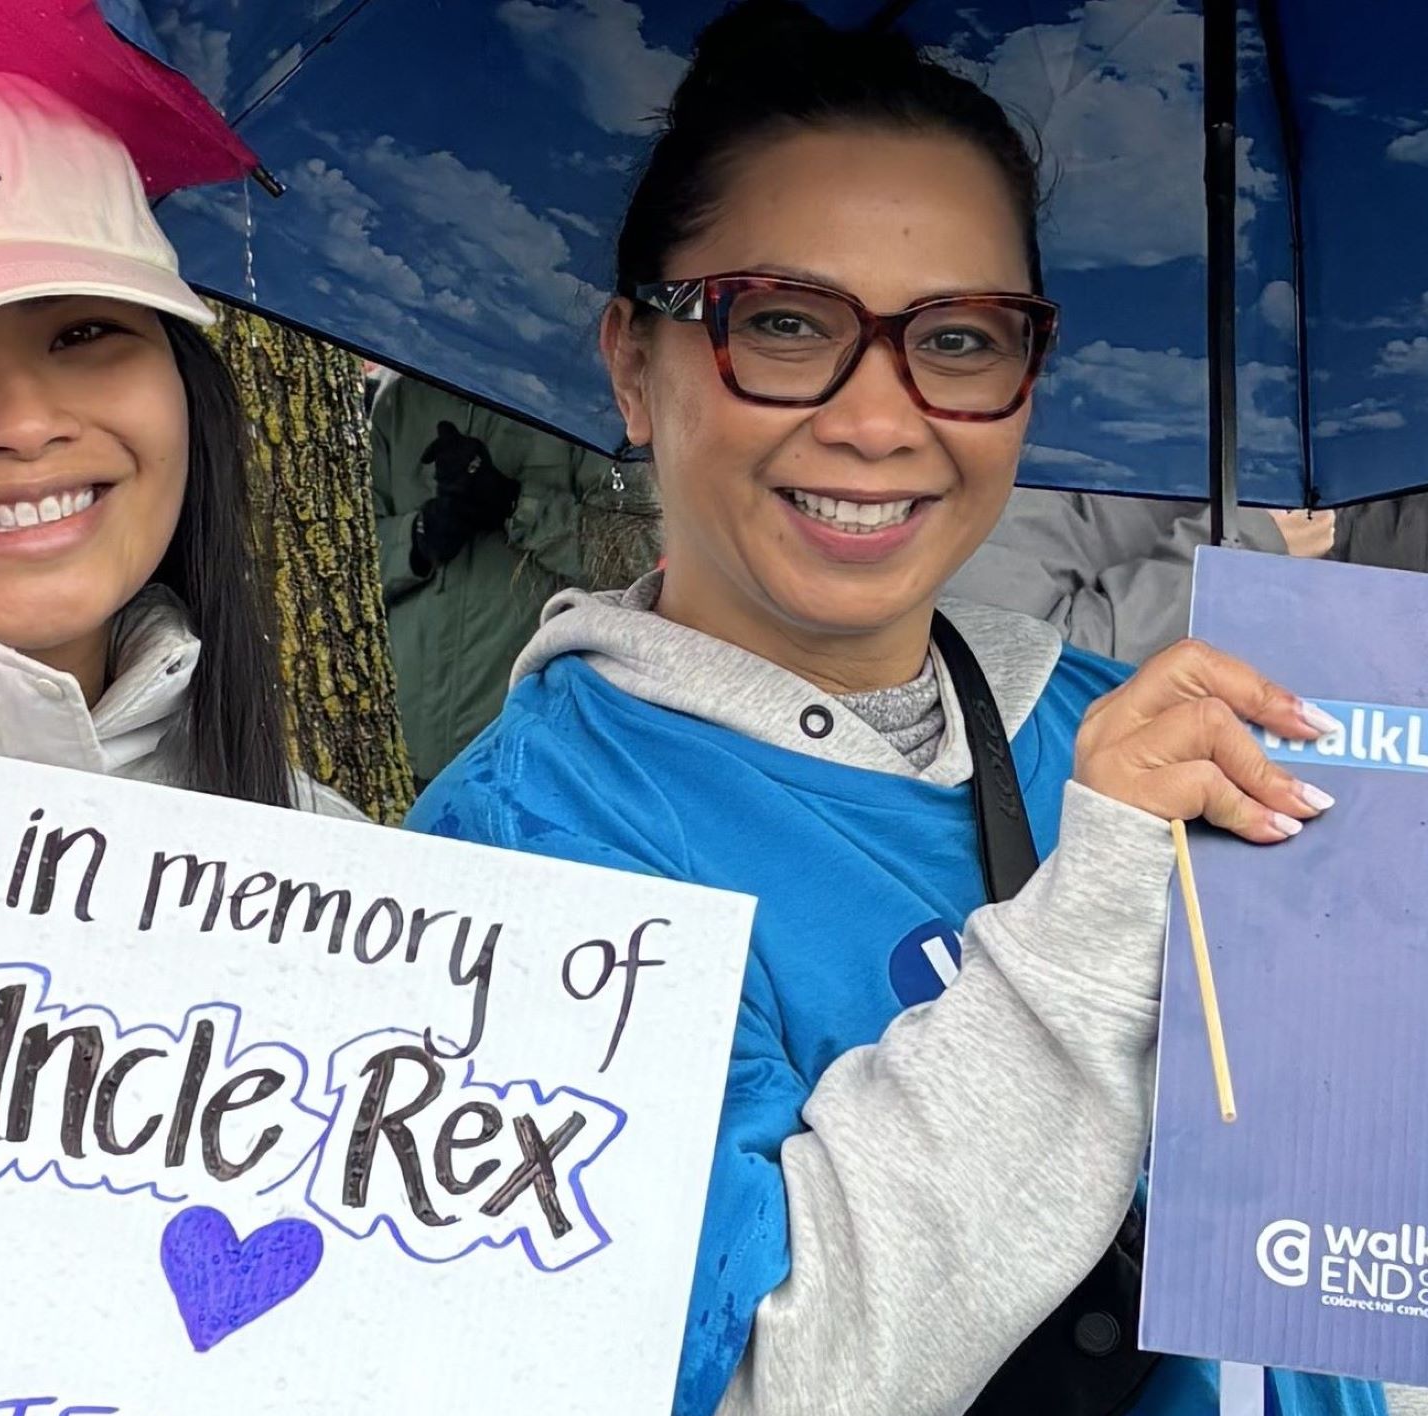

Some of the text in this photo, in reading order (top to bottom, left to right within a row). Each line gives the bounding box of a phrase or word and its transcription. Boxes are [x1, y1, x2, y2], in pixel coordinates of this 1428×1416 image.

[5, 808, 672, 1073] in memory of
[342, 1043, 587, 1240] Rex
[1322, 1255, 1413, 1300] END
[1322, 1294, 1393, 1313] colorectal
